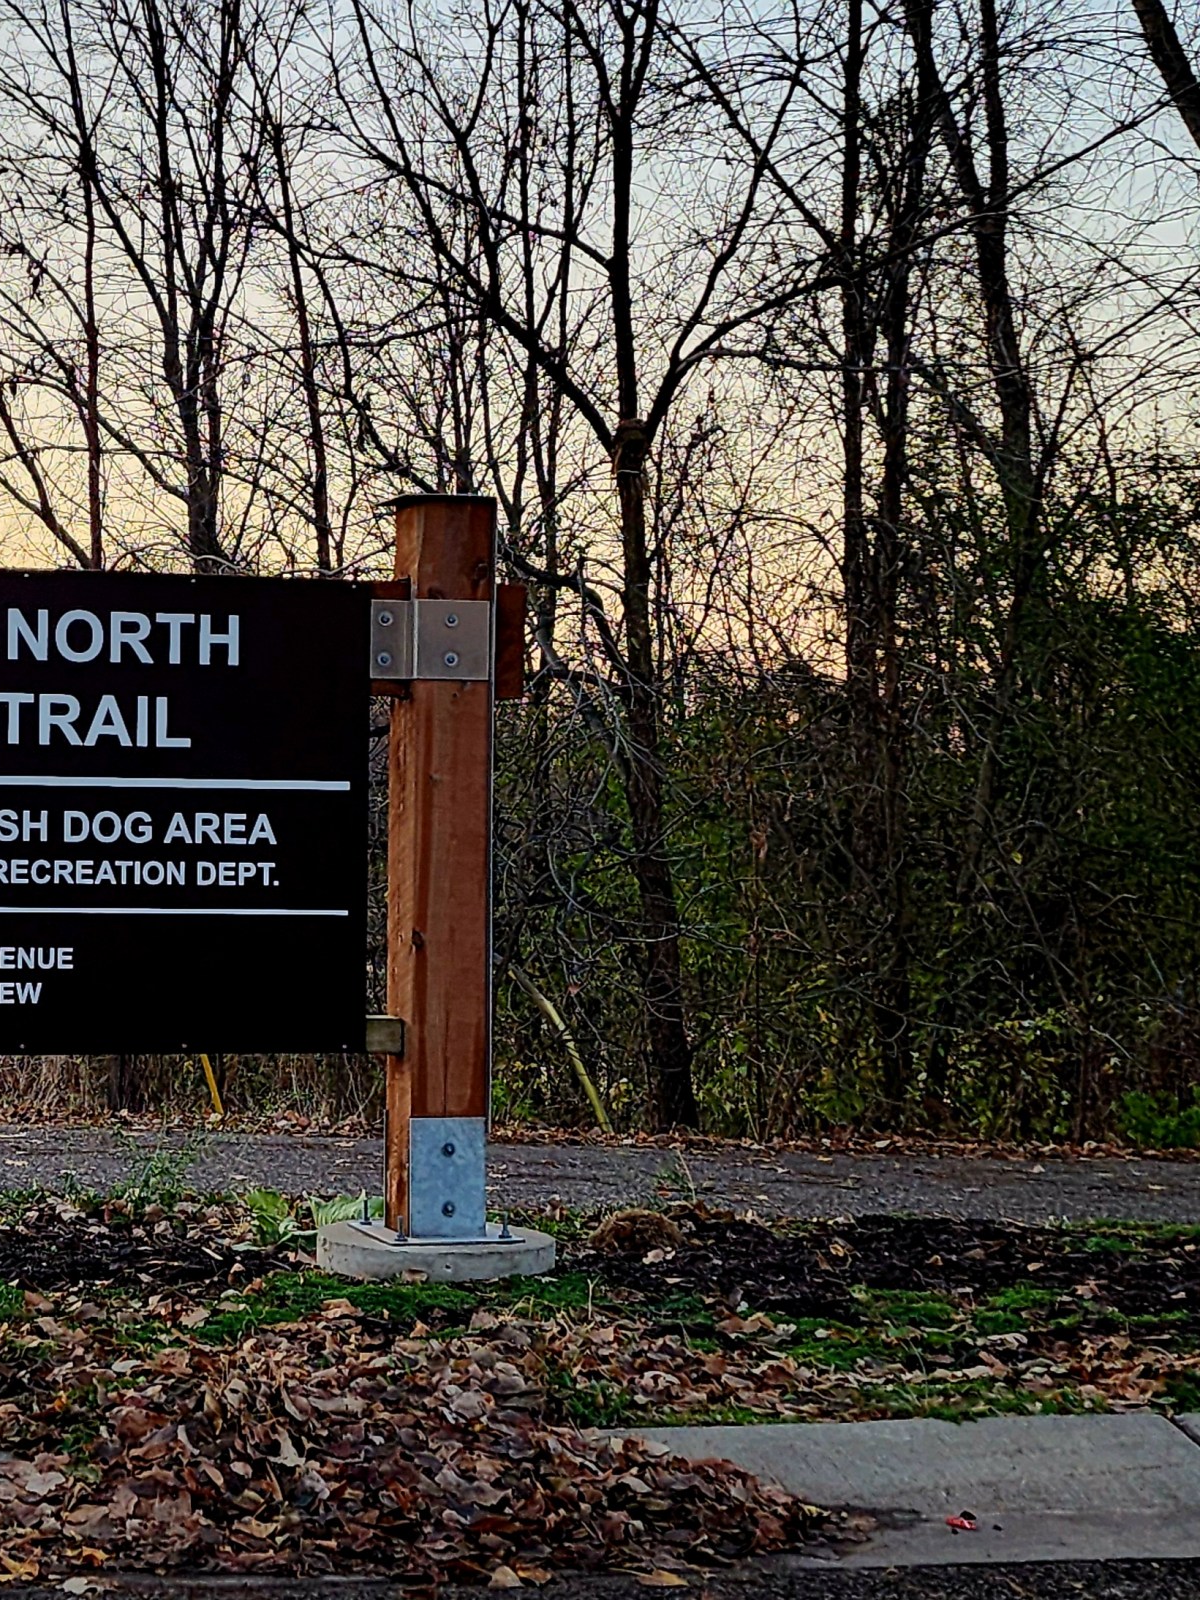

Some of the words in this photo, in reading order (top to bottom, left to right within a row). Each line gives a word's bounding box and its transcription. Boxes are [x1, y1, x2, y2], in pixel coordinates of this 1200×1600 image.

[8, 609, 239, 665] NORTH
[64, 811, 152, 843] DOG
[164, 813, 277, 844] AREA
[197, 862, 279, 886] DEPT.
